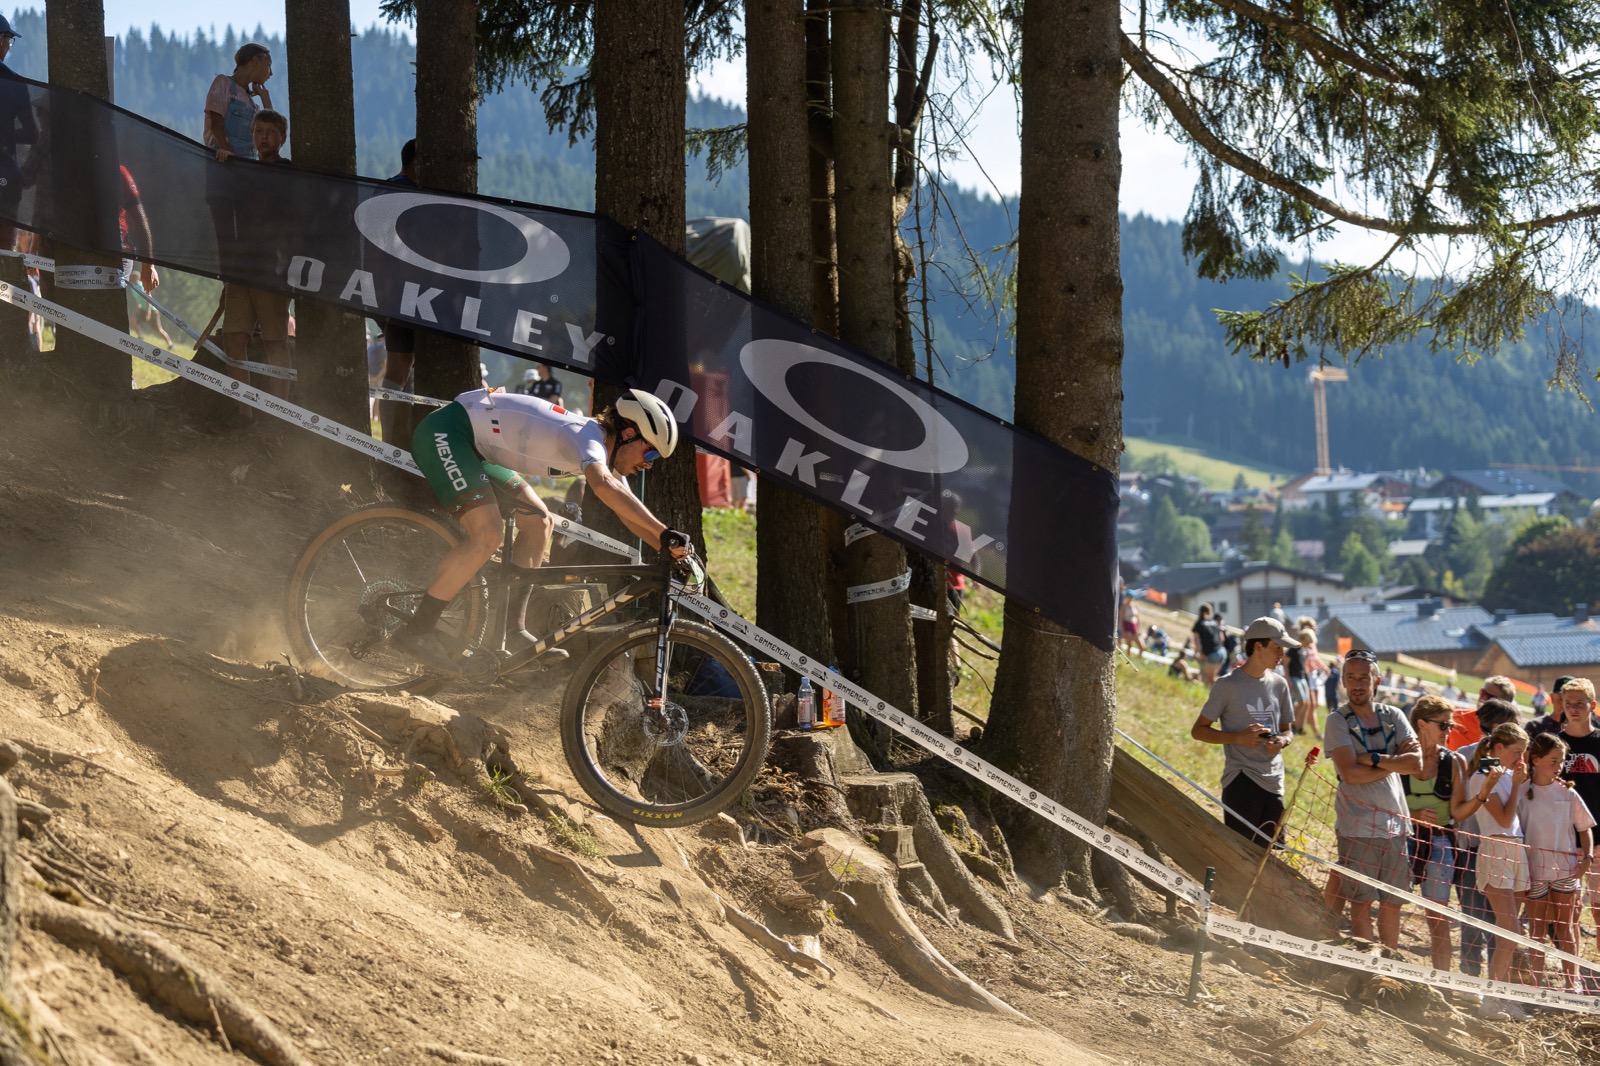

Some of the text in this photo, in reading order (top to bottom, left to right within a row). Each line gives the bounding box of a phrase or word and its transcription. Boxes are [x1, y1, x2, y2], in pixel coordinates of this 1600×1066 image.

[33, 302, 67, 321] COMMENCAL
[287, 255, 606, 364] OAKLEY
[187, 366, 222, 387] COMMENCAL
[265, 400, 302, 420] COMMENCAL
[346, 434, 384, 454] COMMENCAL
[434, 433, 468, 491] MEXICO
[653, 378, 994, 565] OAKLEY
[754, 634, 791, 660] COMMENCAL
[833, 680, 869, 706] COMMENCAL
[911, 726, 946, 751] COMMENCAL
[987, 771, 1022, 796] COMMENCAL
[632, 809, 683, 819] MAXXIS
[1061, 814, 1096, 839] COMMENCAL
[1135, 857, 1168, 881] COMMENCAL
